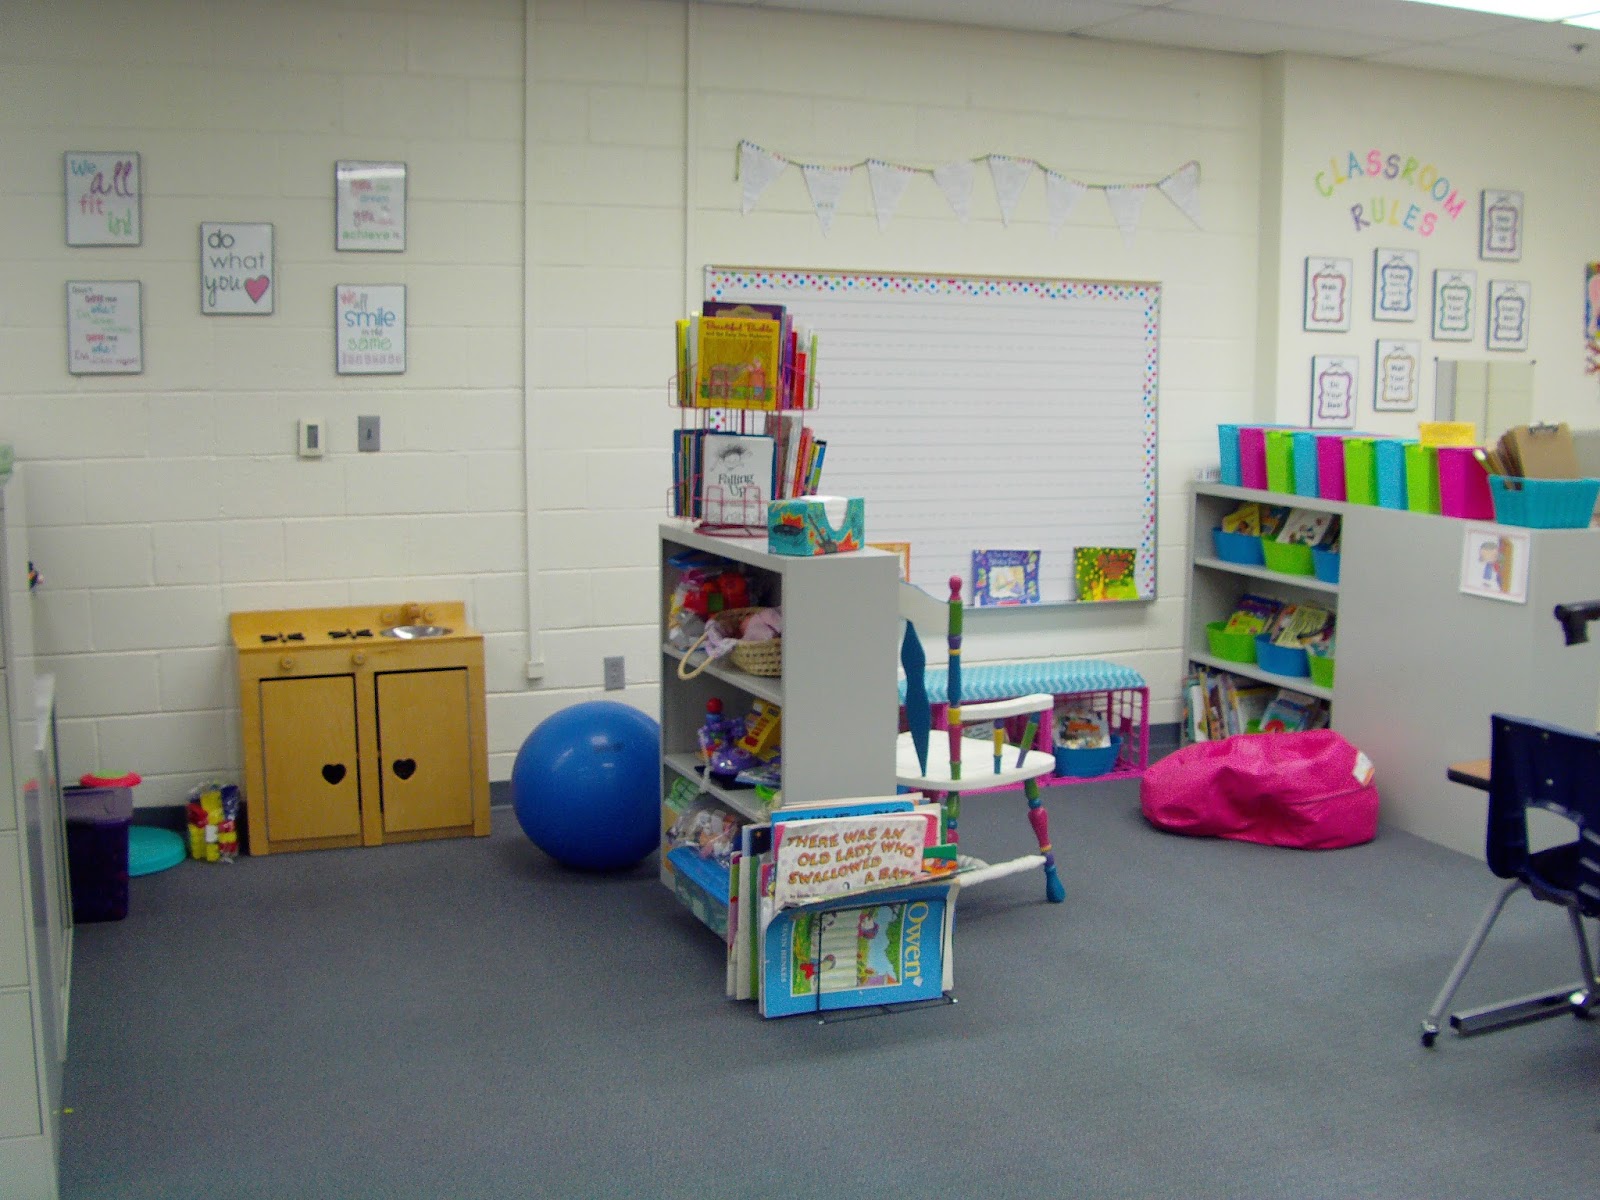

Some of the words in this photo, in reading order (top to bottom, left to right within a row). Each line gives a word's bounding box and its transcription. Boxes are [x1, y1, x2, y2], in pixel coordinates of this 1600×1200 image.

[89, 160, 135, 197] all
[1314, 149, 1467, 221] CLASSROOM
[79, 194, 104, 216] fit
[1350, 196, 1438, 237] RULES
[207, 229, 236, 249] do
[209, 251, 266, 270] what
[203, 274, 242, 308] you
[344, 306, 397, 327] smile
[347, 337, 392, 351] same
[718, 473, 755, 486] Falling
[787, 833, 839, 849] THERE
[842, 826, 877, 844] WAS
[881, 827, 905, 841] AN
[797, 851, 831, 867] OLD
[835, 841, 877, 863] LADY
[881, 840, 916, 858] WHO
[788, 855, 882, 885] SWALLOWED
[864, 870, 875, 885] A
[904, 901, 929, 979] Owen
